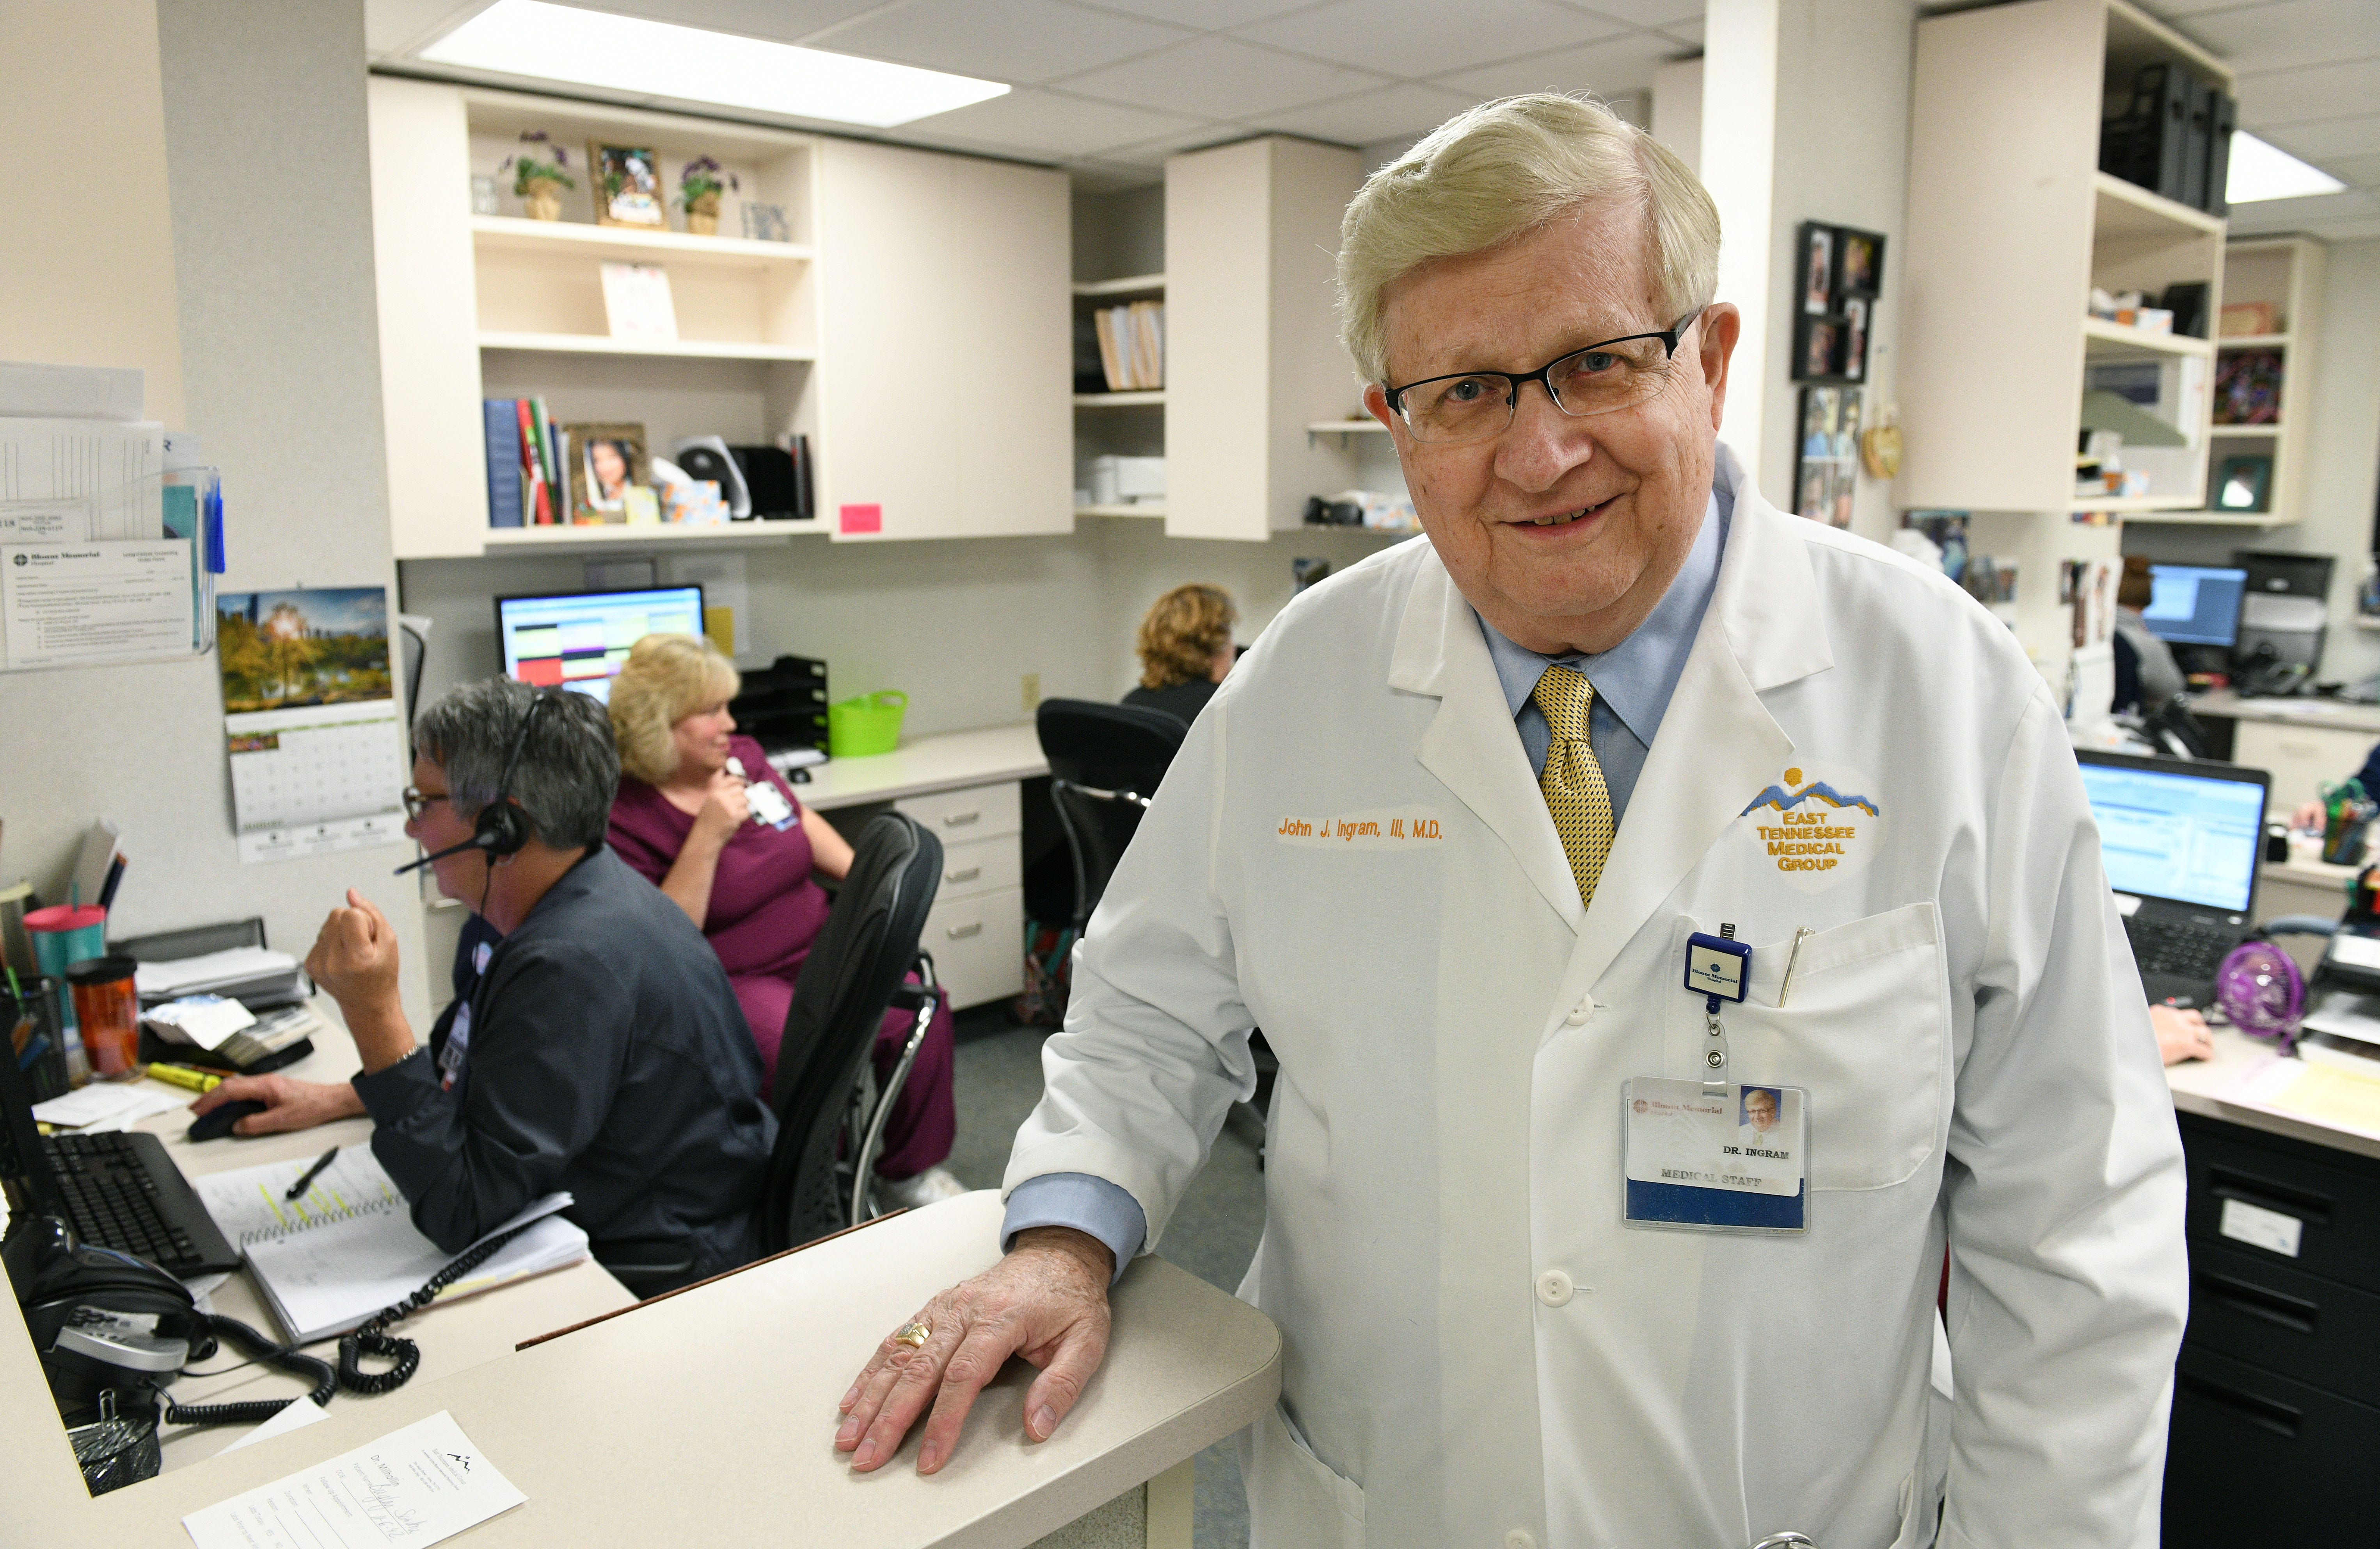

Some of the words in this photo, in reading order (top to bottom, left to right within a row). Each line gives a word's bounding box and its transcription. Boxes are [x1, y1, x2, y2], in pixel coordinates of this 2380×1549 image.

[1279, 818, 1311, 836] John
[1320, 820, 1330, 838] J.
[1337, 819, 1380, 841] Ingram,
[1390, 819, 1405, 840] III,
[1412, 820, 1442, 839] M.D.
[1757, 826, 1855, 839] TENNESSEE
[1767, 841, 1845, 855] MEDICAL
[1778, 857, 1838, 871] GROUP
[1692, 968, 1710, 976] Blount
[1711, 973, 1738, 983] Memorial
[1652, 1101, 1679, 1110] Blount
[1682, 1104, 1722, 1114] Memorial
[1723, 1146, 1741, 1155] DR.
[1745, 1147, 1789, 1160] INGRAM
[1661, 1168, 1716, 1183] MEDICAL
[1721, 1174, 1762, 1187] STAFF
[370, 1455, 379, 1464] Dr.
[377, 1463, 401, 1487] Milhollin
